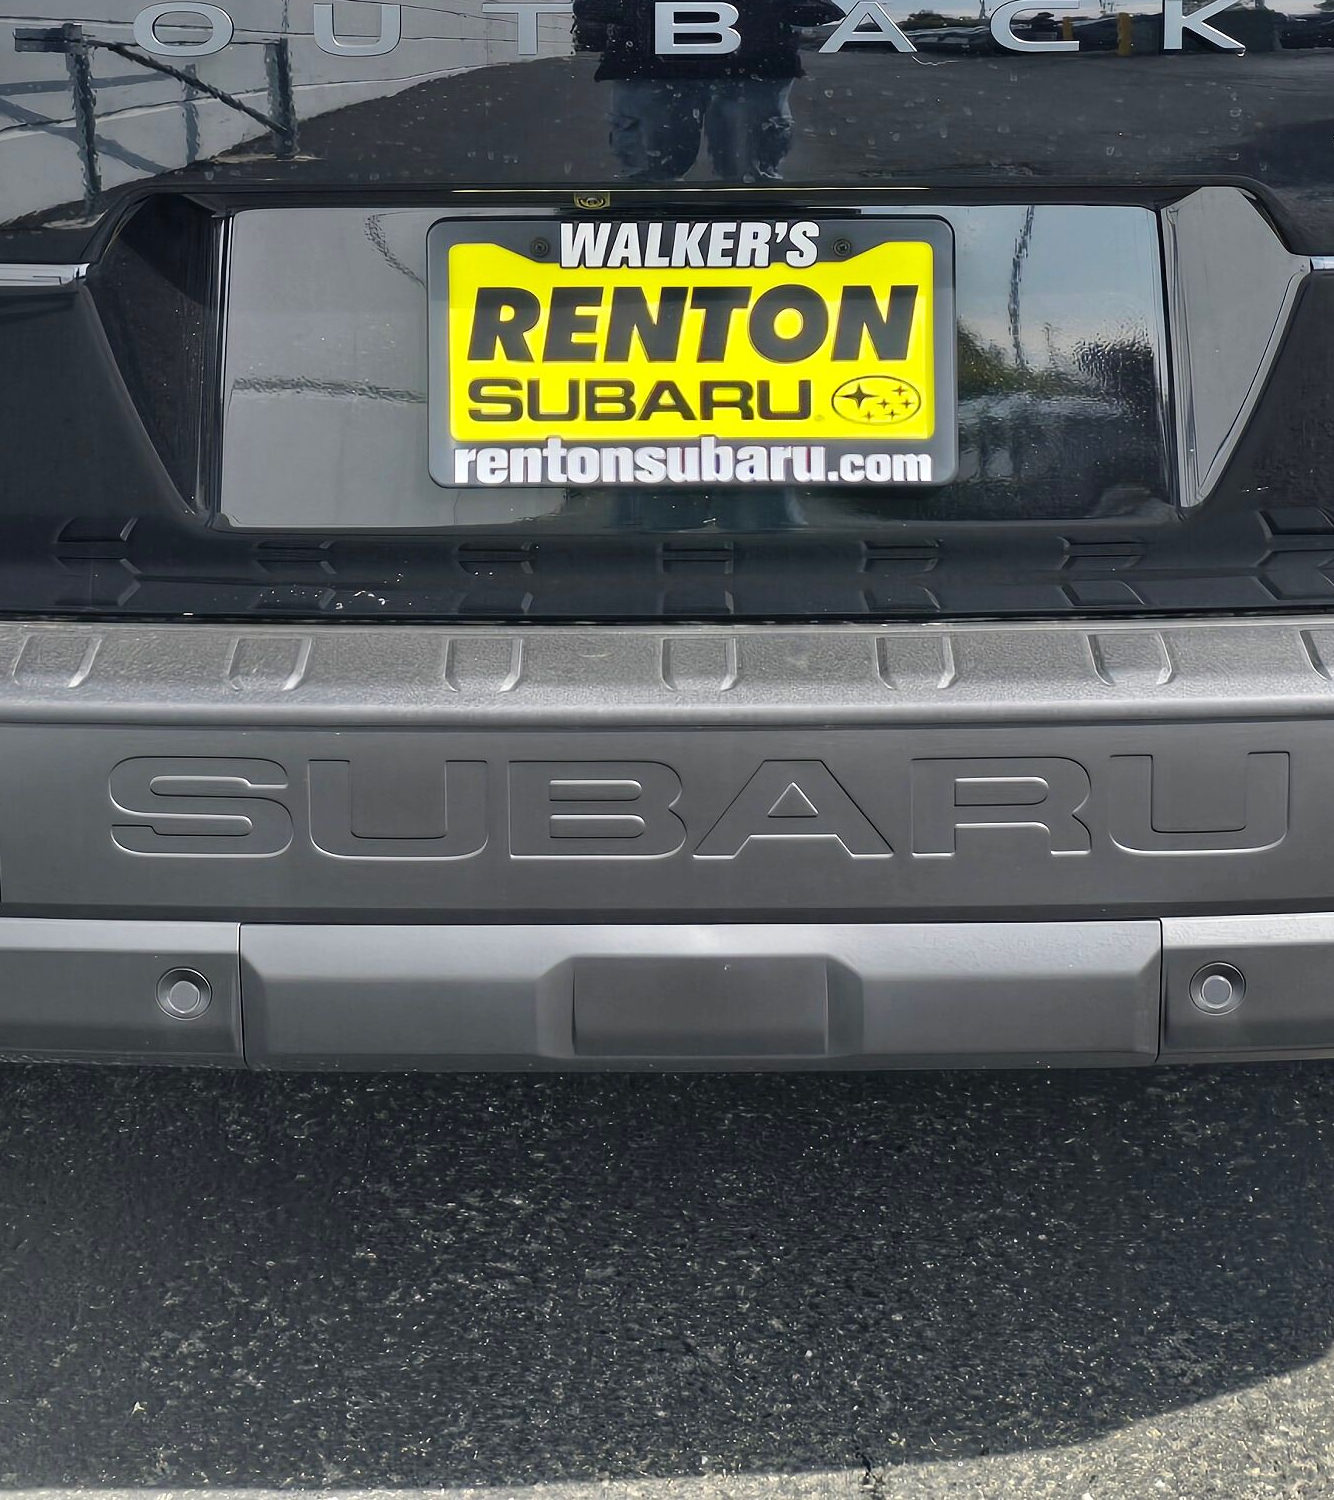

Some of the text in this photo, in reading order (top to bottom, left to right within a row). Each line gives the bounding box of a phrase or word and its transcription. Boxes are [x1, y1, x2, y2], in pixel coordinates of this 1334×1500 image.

[559, 220, 821, 269] WALKER'S
[466, 283, 920, 364] RENTON
[468, 378, 813, 422] SUBARU
[453, 434, 933, 485] rentonsubaru.com
[107, 749, 1292, 862] SUBARU
